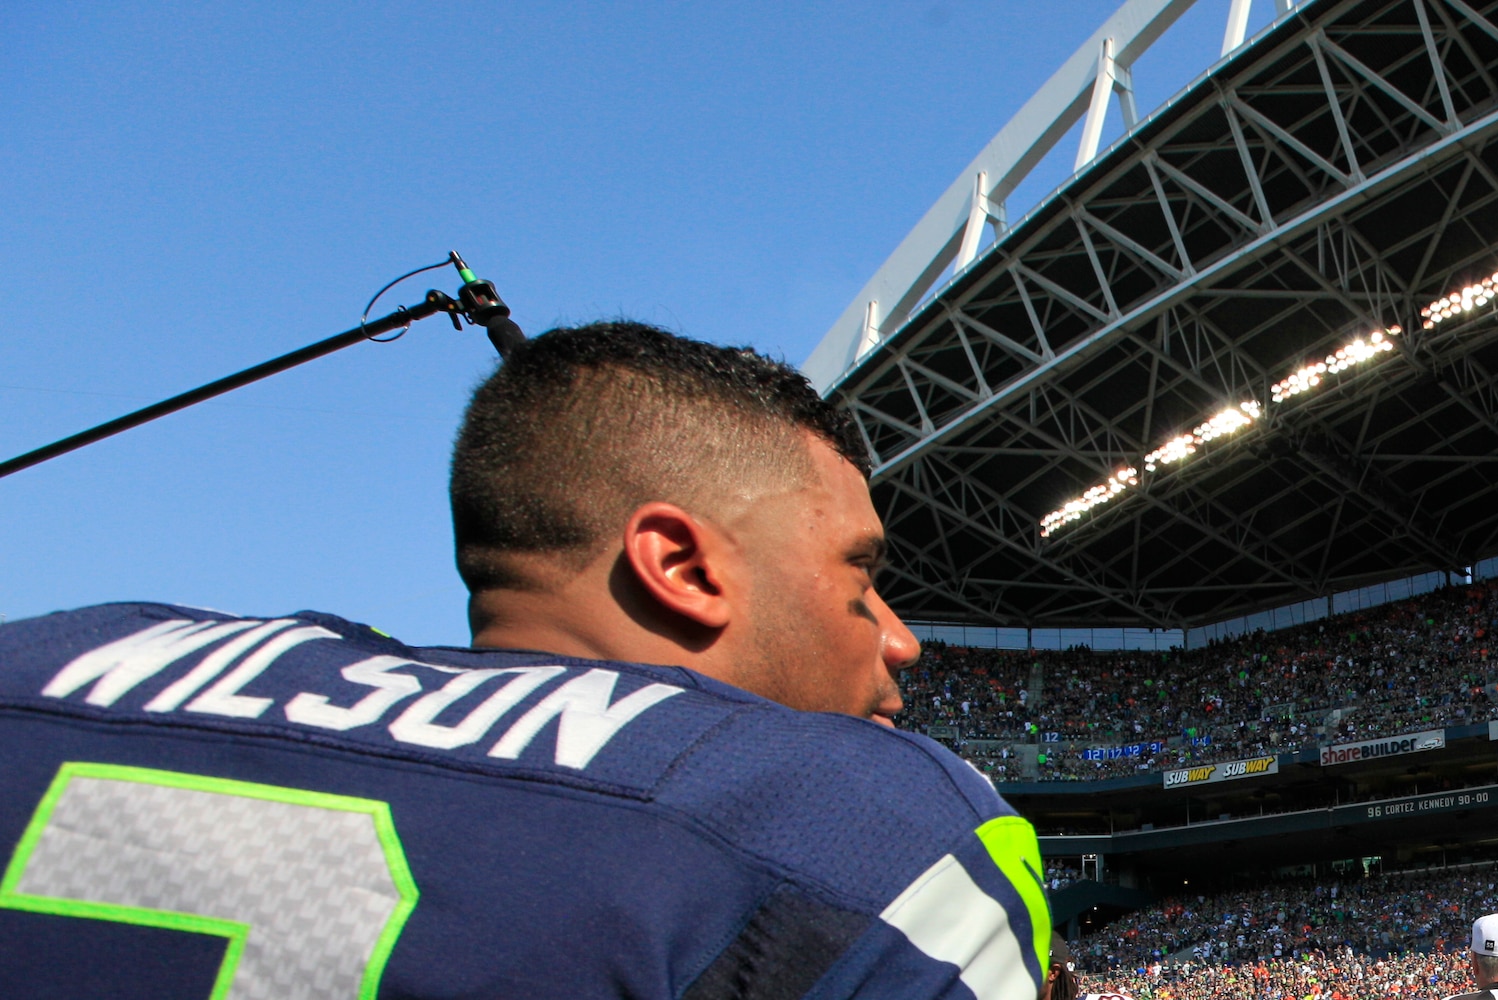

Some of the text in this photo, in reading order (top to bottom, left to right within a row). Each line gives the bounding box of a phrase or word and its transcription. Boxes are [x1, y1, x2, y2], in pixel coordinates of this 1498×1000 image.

[41, 617, 685, 771] WILSON
[1045, 732, 1059, 743] 12
[1166, 765, 1216, 786] SUBWAY
[1223, 756, 1275, 778] SUBWAY
[1368, 792, 1489, 818] 96 CORTEZ KENNEDY 90-00
